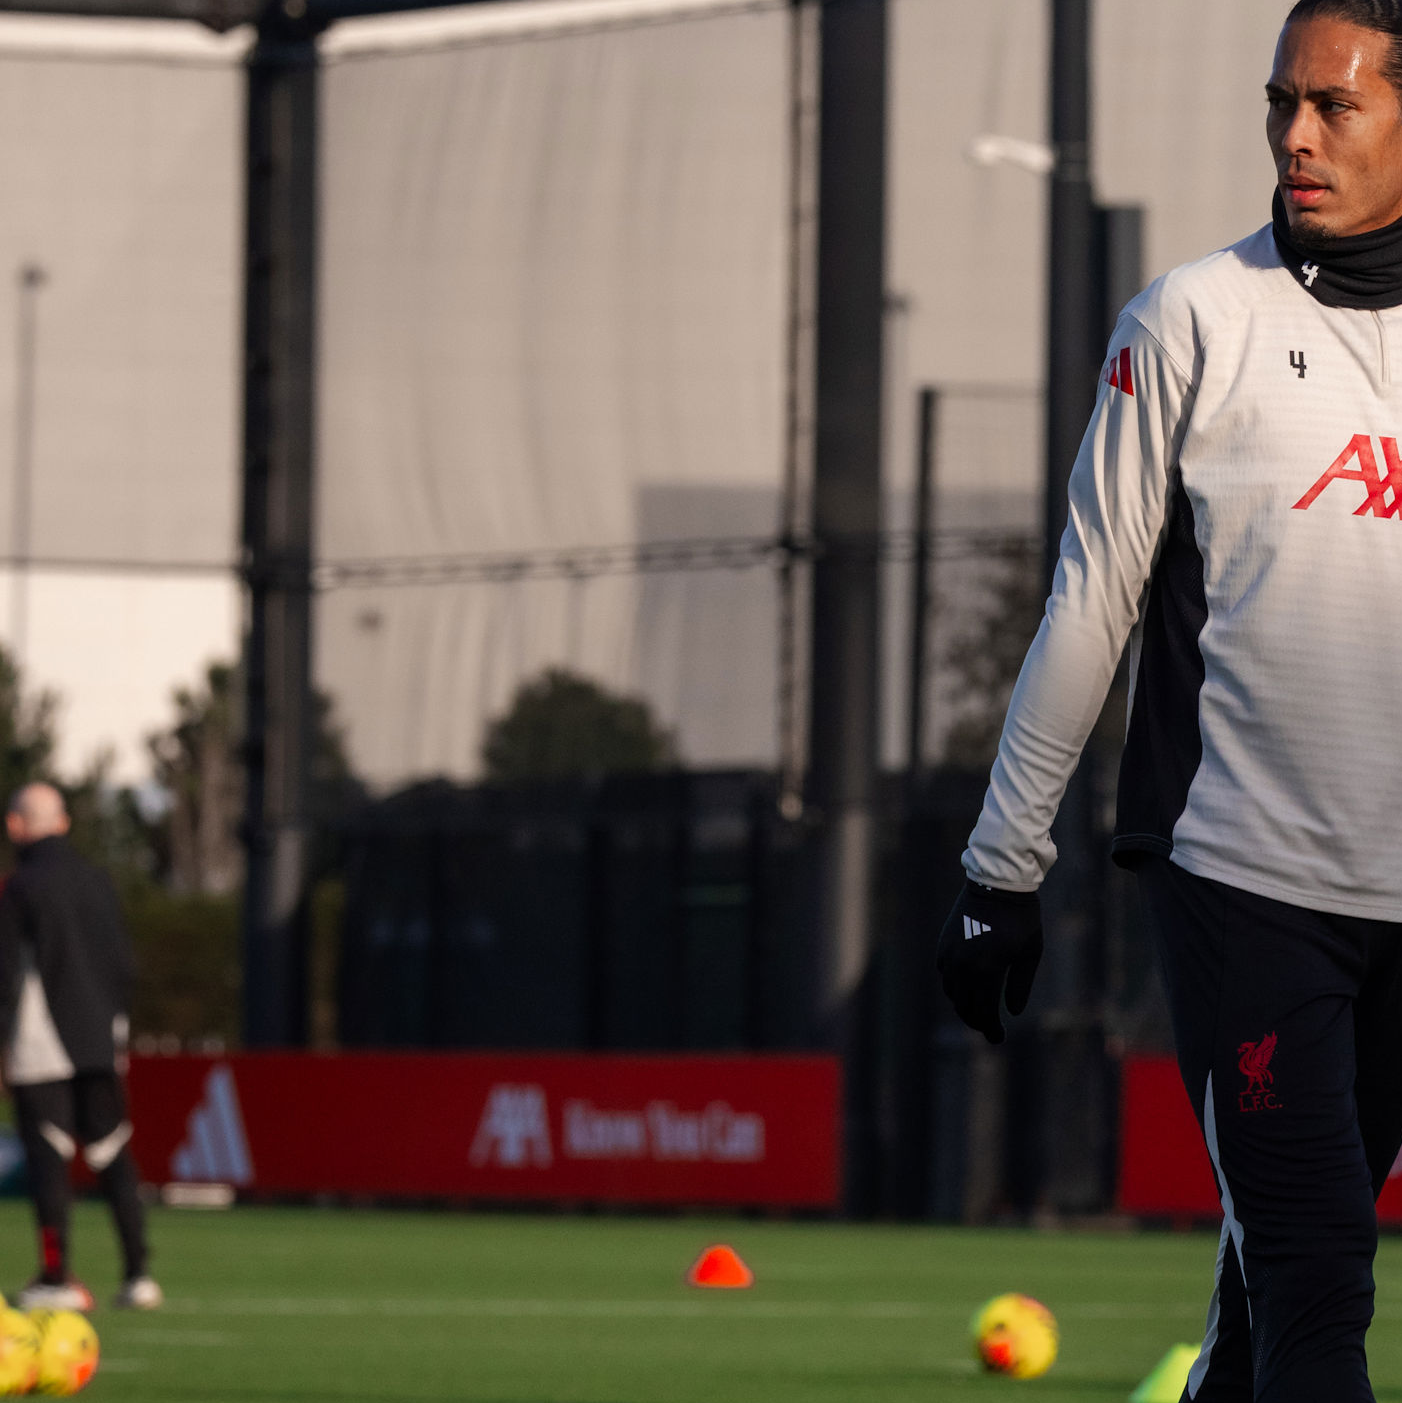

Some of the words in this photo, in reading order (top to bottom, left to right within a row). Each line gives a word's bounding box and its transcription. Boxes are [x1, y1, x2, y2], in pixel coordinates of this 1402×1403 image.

[1301, 260, 1320, 287] 4
[1289, 350, 1307, 378] 4
[1239, 1094, 1283, 1112] L.F.C.
